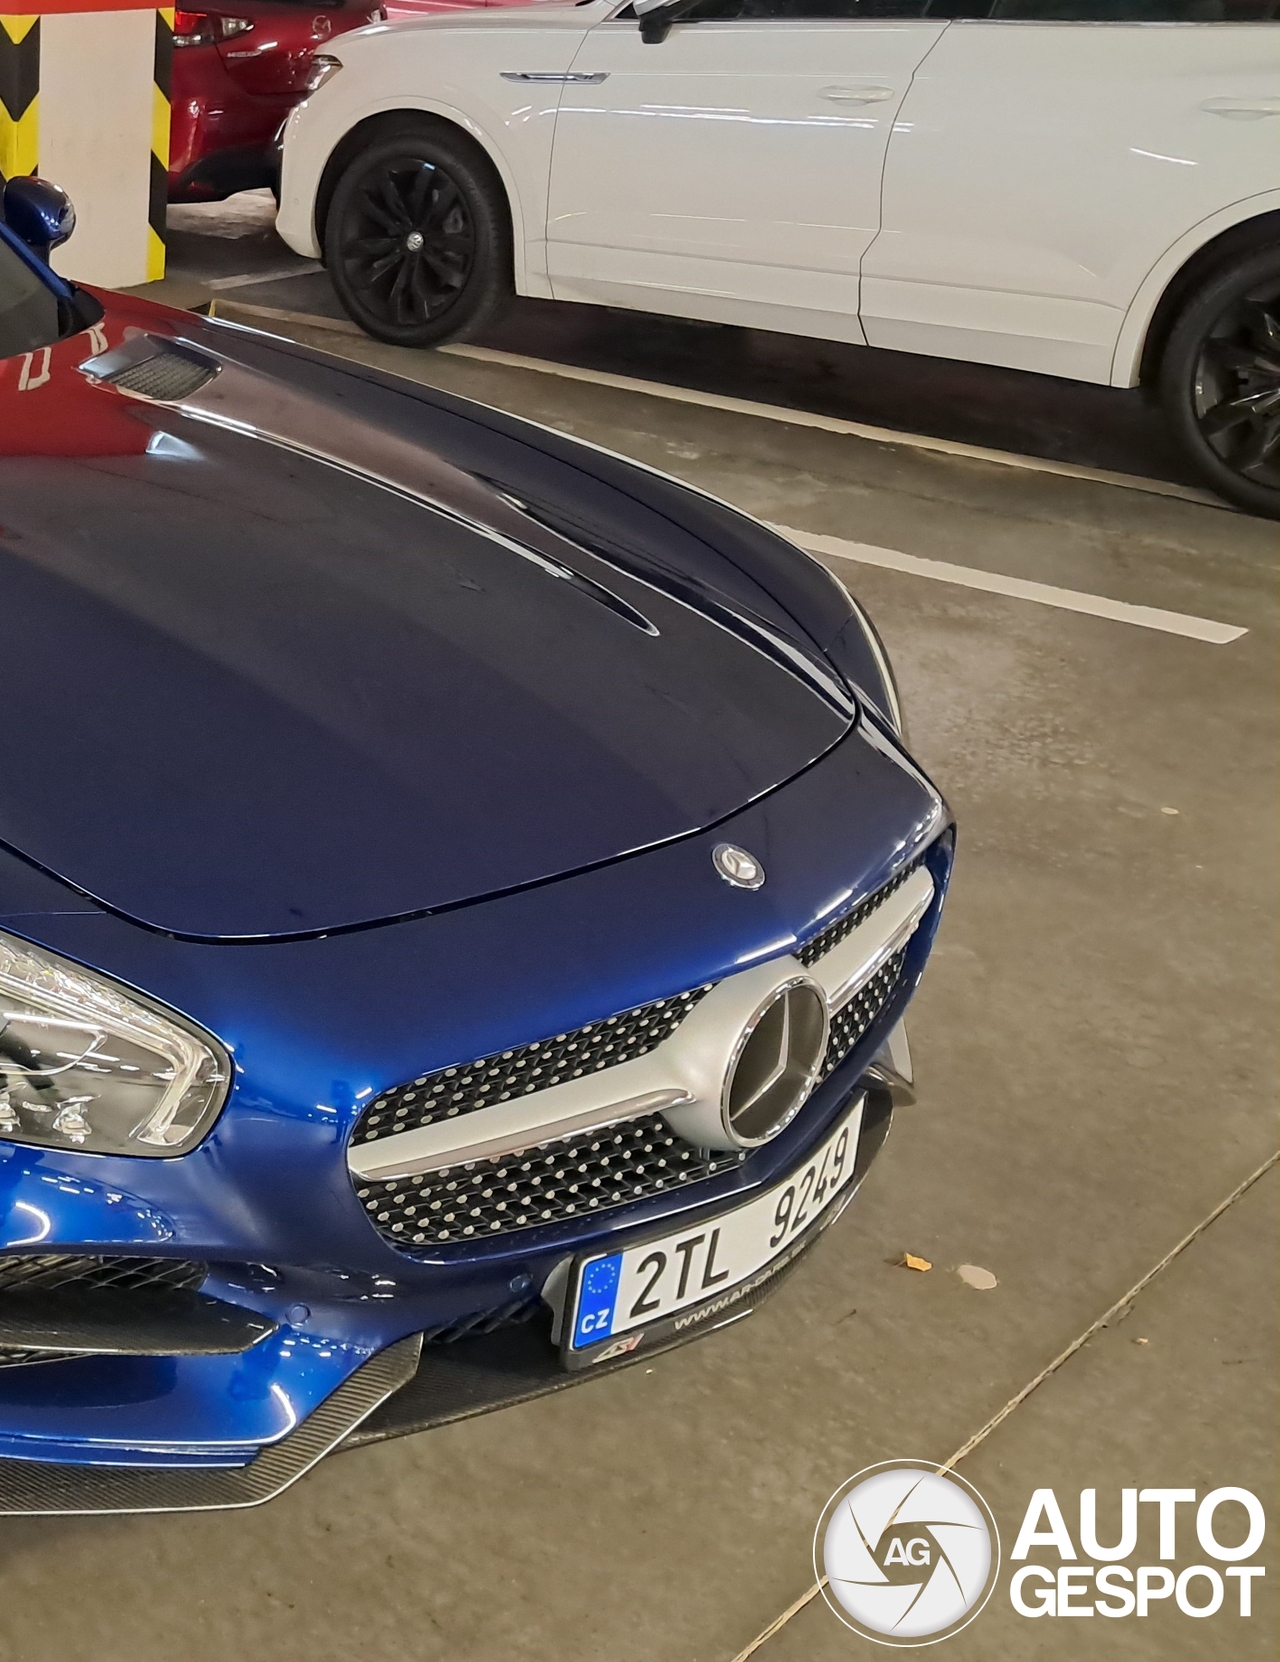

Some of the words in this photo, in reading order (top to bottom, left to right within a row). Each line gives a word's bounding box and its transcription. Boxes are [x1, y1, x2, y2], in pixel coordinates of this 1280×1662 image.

[629, 1227, 730, 1319] 2TL
[770, 1126, 849, 1248] 9249
[580, 1308, 611, 1335] CZ
